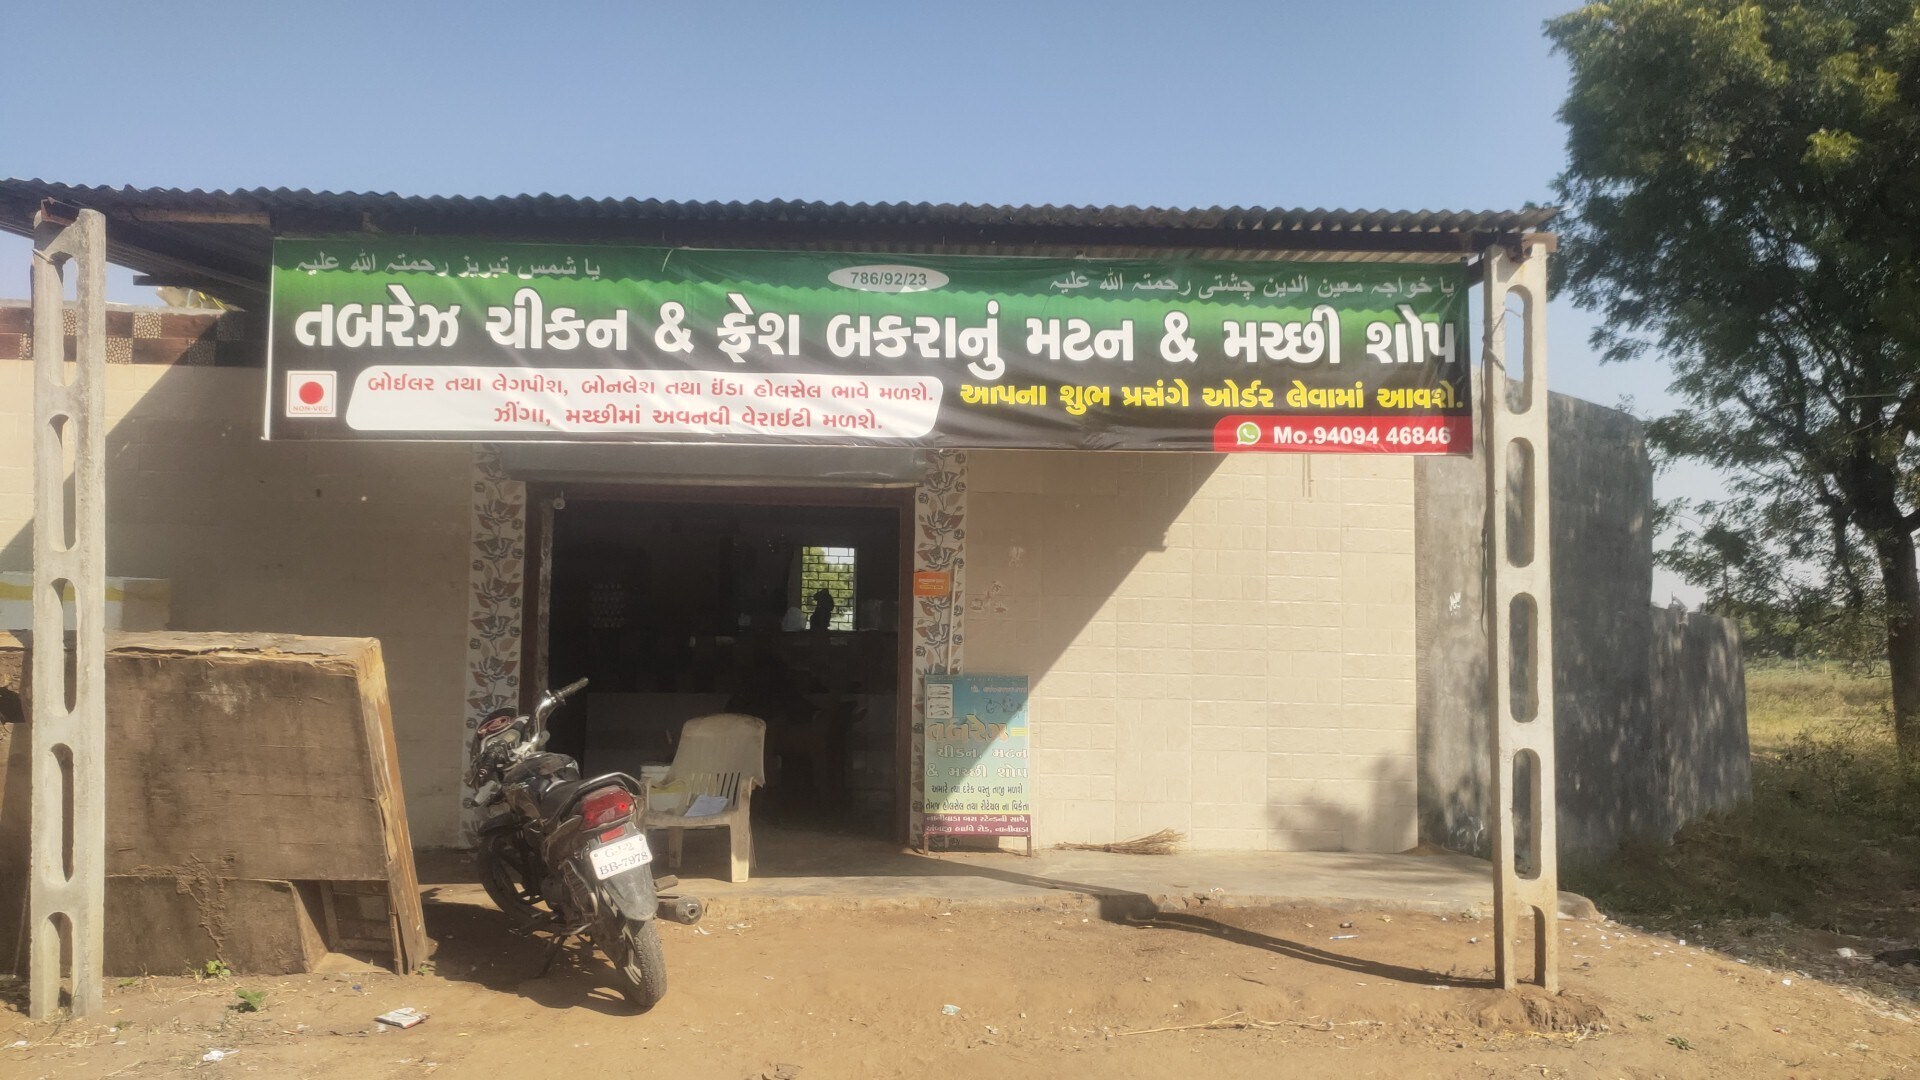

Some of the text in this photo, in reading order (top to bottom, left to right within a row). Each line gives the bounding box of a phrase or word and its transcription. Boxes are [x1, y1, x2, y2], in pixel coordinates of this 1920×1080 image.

[517, 256, 577, 279] شمس
[850, 271, 928, 286] 786/92/23
[295, 284, 1456, 380] તબરેઝ ચીકન & ફ્રેશ બકરાનું મટન & મચ્છી શોપ
[367, 371, 435, 391] બોઈલર
[445, 377, 481, 391] તથા
[492, 373, 568, 396] લેગપીશ,
[581, 374, 656, 394] બોનલેશ
[665, 381, 701, 395] તથા
[754, 379, 821, 398] હોલસેલ
[831, 381, 869, 399] ભાવે
[879, 381, 933, 401] મળશે.
[960, 378, 1464, 416] આપના શુભ પ્રસંગે ઓર્ડર લેવામાં આવશે.
[494, 401, 883, 430] ઝીંગા, મચ્છીમાં અવનવી વેરાઈટી મળશે.
[1273, 426, 1451, 445] Mo.94094 46846
[927, 713, 1009, 743] તબરેઝ
[992, 748, 1028, 759] મટન
[926, 762, 939, 777] &
[997, 763, 1028, 778] શોપ
[962, 782, 975, 793] દરેક
[599, 851, 649, 875] BB-7978
